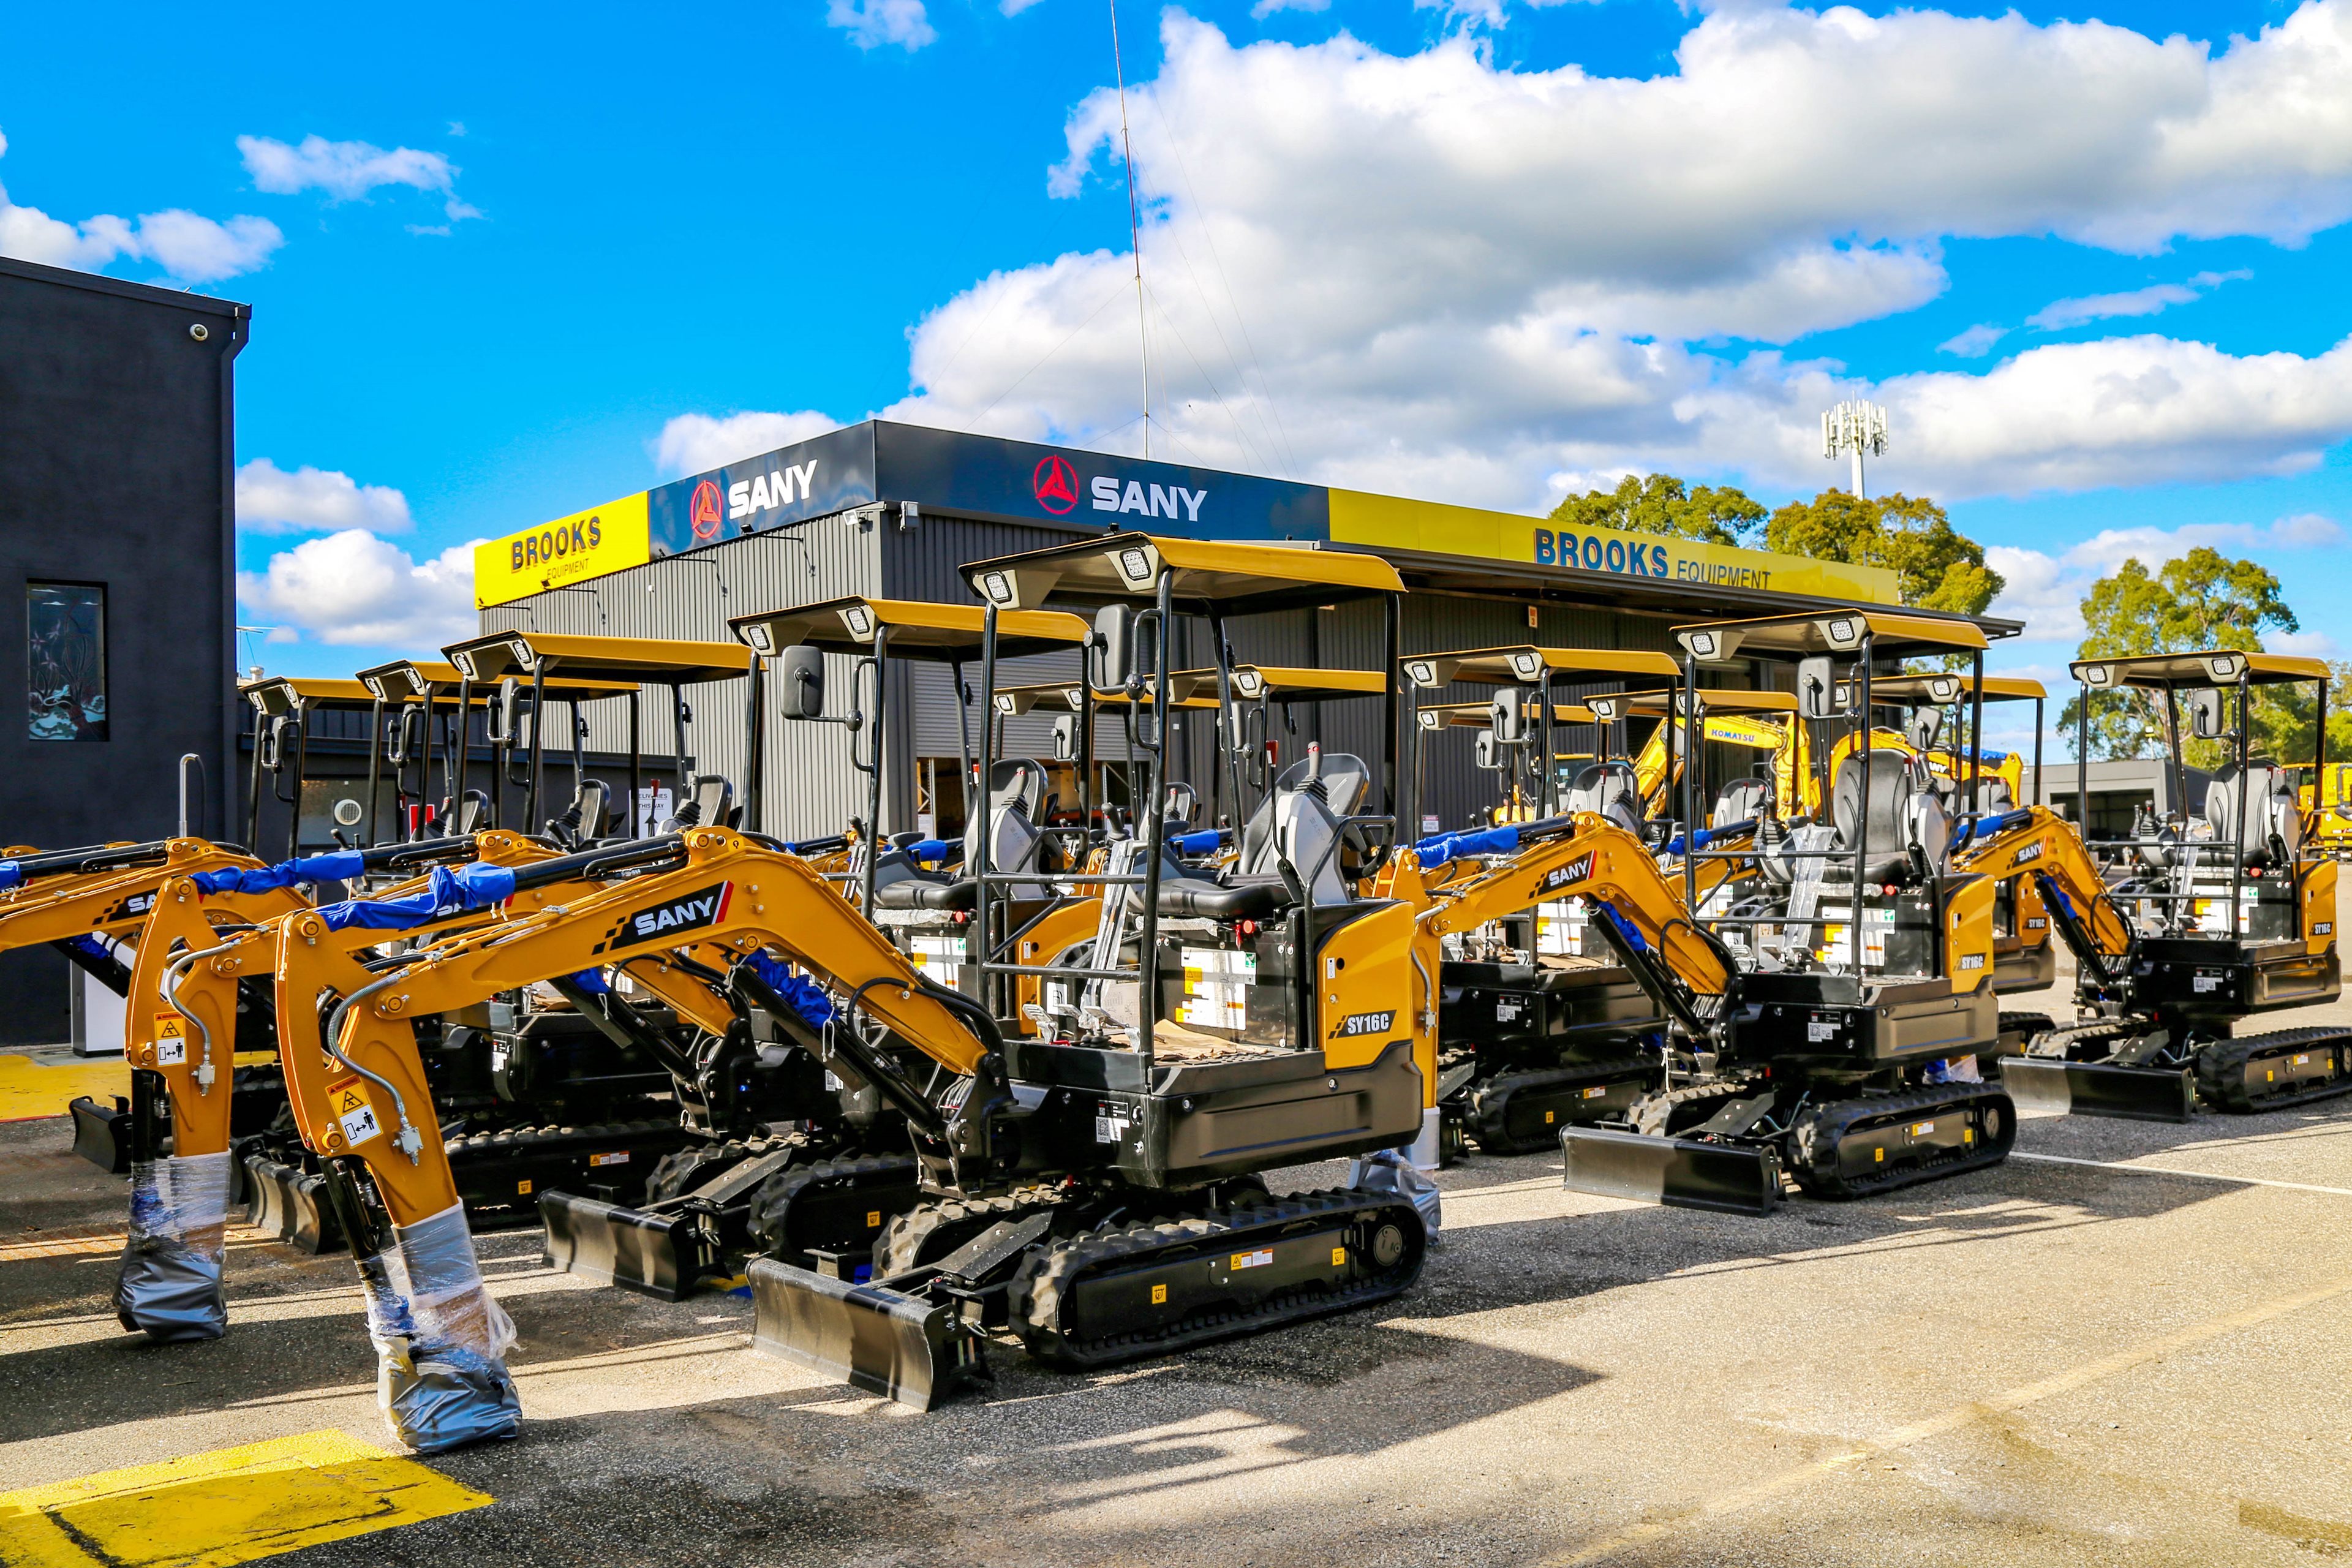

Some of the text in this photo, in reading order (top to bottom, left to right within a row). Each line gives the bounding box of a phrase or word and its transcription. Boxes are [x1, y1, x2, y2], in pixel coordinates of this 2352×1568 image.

[728, 459, 818, 519] SANY
[1091, 476, 1208, 522] SANY
[511, 516, 601, 573] BROOKS
[547, 558, 589, 579] EQUIPMENT
[1534, 528, 1771, 590] BROOKS EQUIPMENT
[1711, 729, 1755, 742] KOMATSU
[2018, 842, 2043, 862] SANY
[1549, 859, 1588, 886] SANY
[127, 894, 157, 913] SA
[635, 896, 714, 936] SANY
[2029, 919, 2045, 928] SY16C
[2315, 923, 2331, 935] SY16C
[1961, 956, 1983, 969] SY16C
[1348, 1013, 1389, 1034] SY16C
